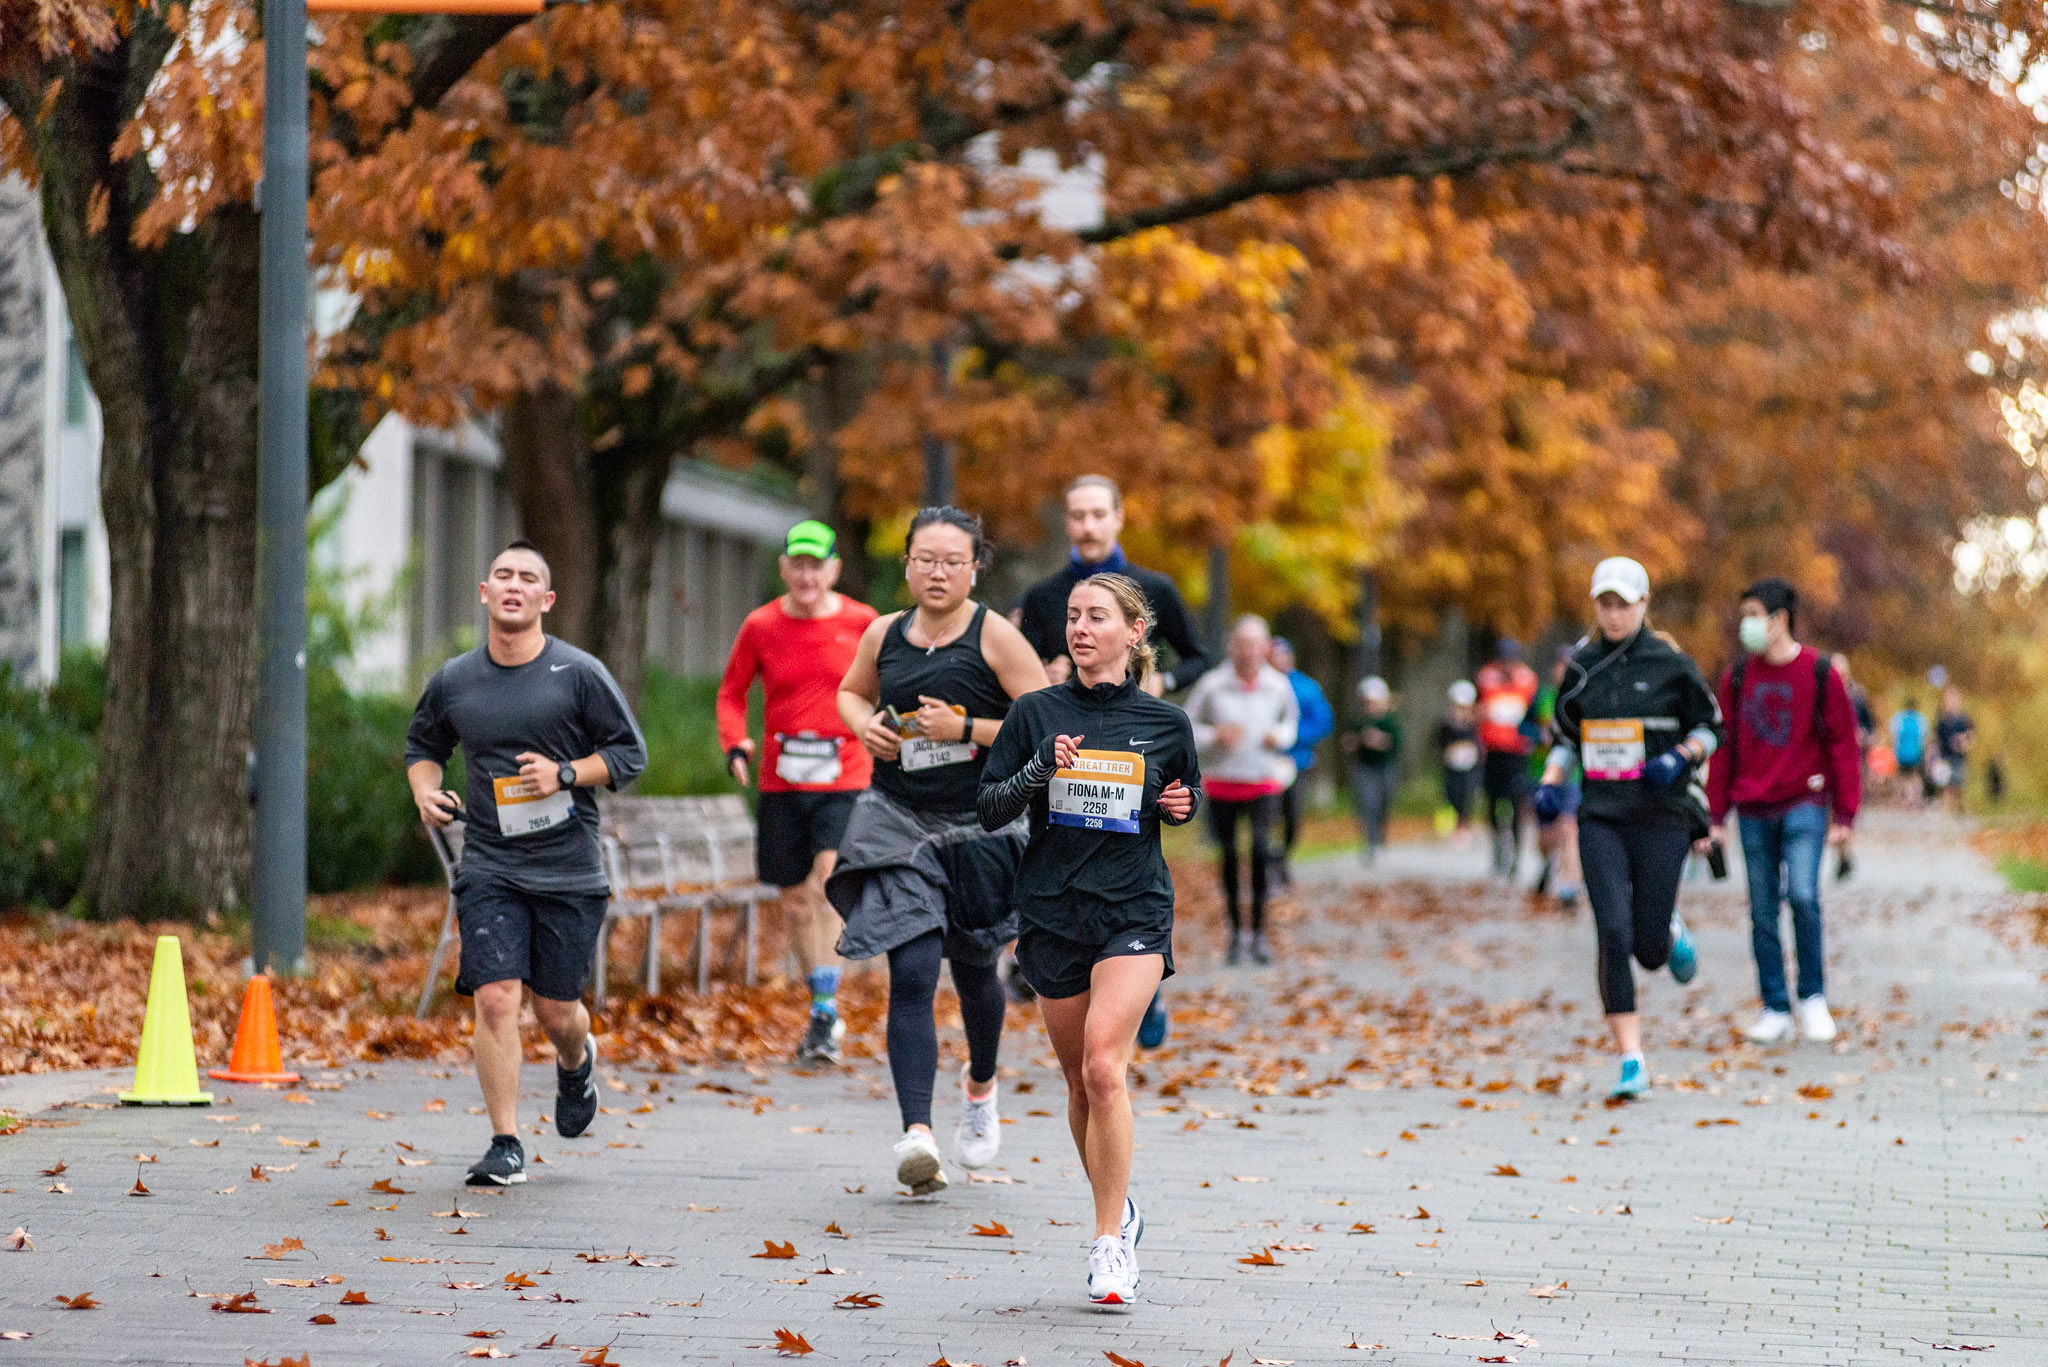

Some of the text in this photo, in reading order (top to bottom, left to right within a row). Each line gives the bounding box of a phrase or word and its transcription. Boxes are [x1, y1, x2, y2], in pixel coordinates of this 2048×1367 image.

[929, 751, 951, 764] 2142
[1074, 760, 1131, 774] GREAT TREK
[1067, 783, 1125, 800] FIONA M-M
[1082, 801, 1108, 815] 2258
[1085, 817, 1103, 829] 2258
